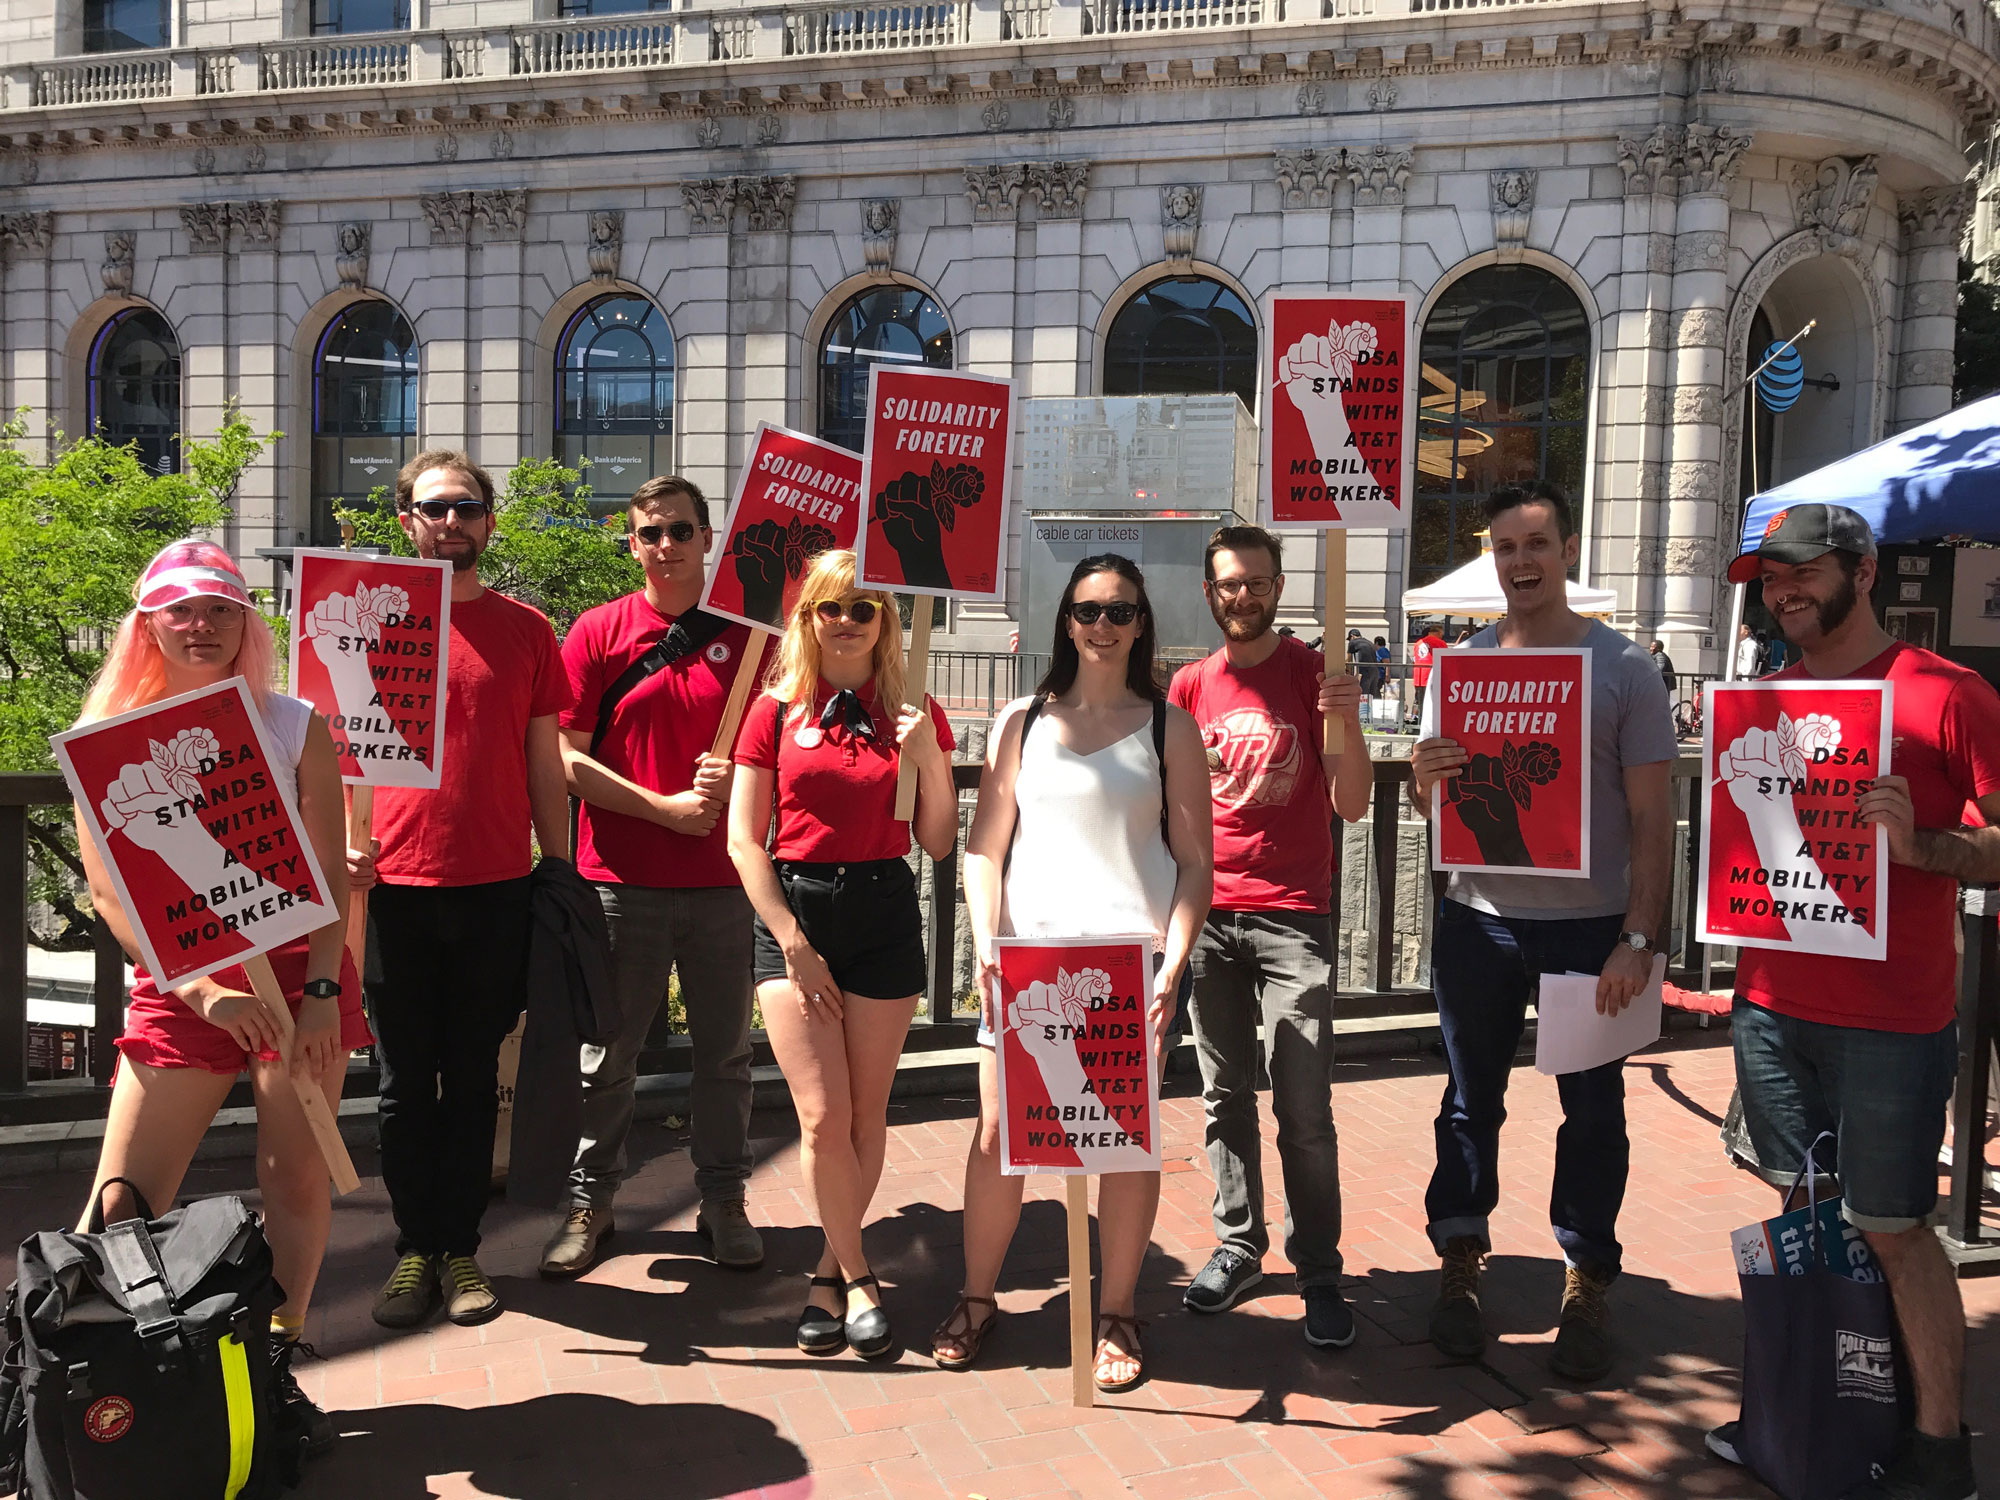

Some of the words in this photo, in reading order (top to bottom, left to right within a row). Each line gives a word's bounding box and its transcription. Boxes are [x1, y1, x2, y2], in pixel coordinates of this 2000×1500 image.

[1357, 350, 1399, 366] DSA
[1311, 377, 1399, 393] STANDS
[882, 397, 1001, 430] SOLIDARITY
[1346, 404, 1399, 421] WITH
[895, 428, 985, 458] FOREVER
[1343, 431, 1398, 448] AT&T
[759, 452, 862, 502] SOLIDARITY
[1289, 458, 1397, 475] MOBILITY
[763, 481, 844, 524] FOREVER
[1290, 485, 1396, 502] WORKERS
[1036, 525, 1070, 541] cable
[1074, 529, 1093, 541] car
[1098, 525, 1139, 541] tickets
[385, 613, 433, 631] DSA
[337, 636, 433, 658] STANDS
[371, 665, 433, 684] WITH
[368, 691, 432, 710] AT&T
[1448, 680, 1574, 704] SOLIDARITY
[1463, 711, 1558, 734] FOREVER
[199, 744, 255, 777] DSA
[335, 741, 428, 762] ORKERS
[1811, 747, 1870, 766] DSA
[1757, 776, 1870, 799] STANDS
[154, 771, 268, 826] STANDS
[207, 799, 278, 839] WITH
[222, 827, 289, 869] AT&T
[1796, 840, 1871, 862] AT&T
[165, 854, 299, 923] MOBILITY
[1729, 866, 1871, 894] MOBILITY
[176, 883, 312, 951] WORKERS
[1729, 897, 1869, 926] WORKERS
[1090, 995, 1138, 1013] DSA
[1043, 1022, 1140, 1041] STANDS
[1081, 1050, 1141, 1067] WITH
[1080, 1078, 1143, 1095] AT&T
[1026, 1104, 1145, 1121] MOBILITY
[1027, 1131, 1145, 1148] WORKERS
[1839, 1334, 1866, 1361] COLE
